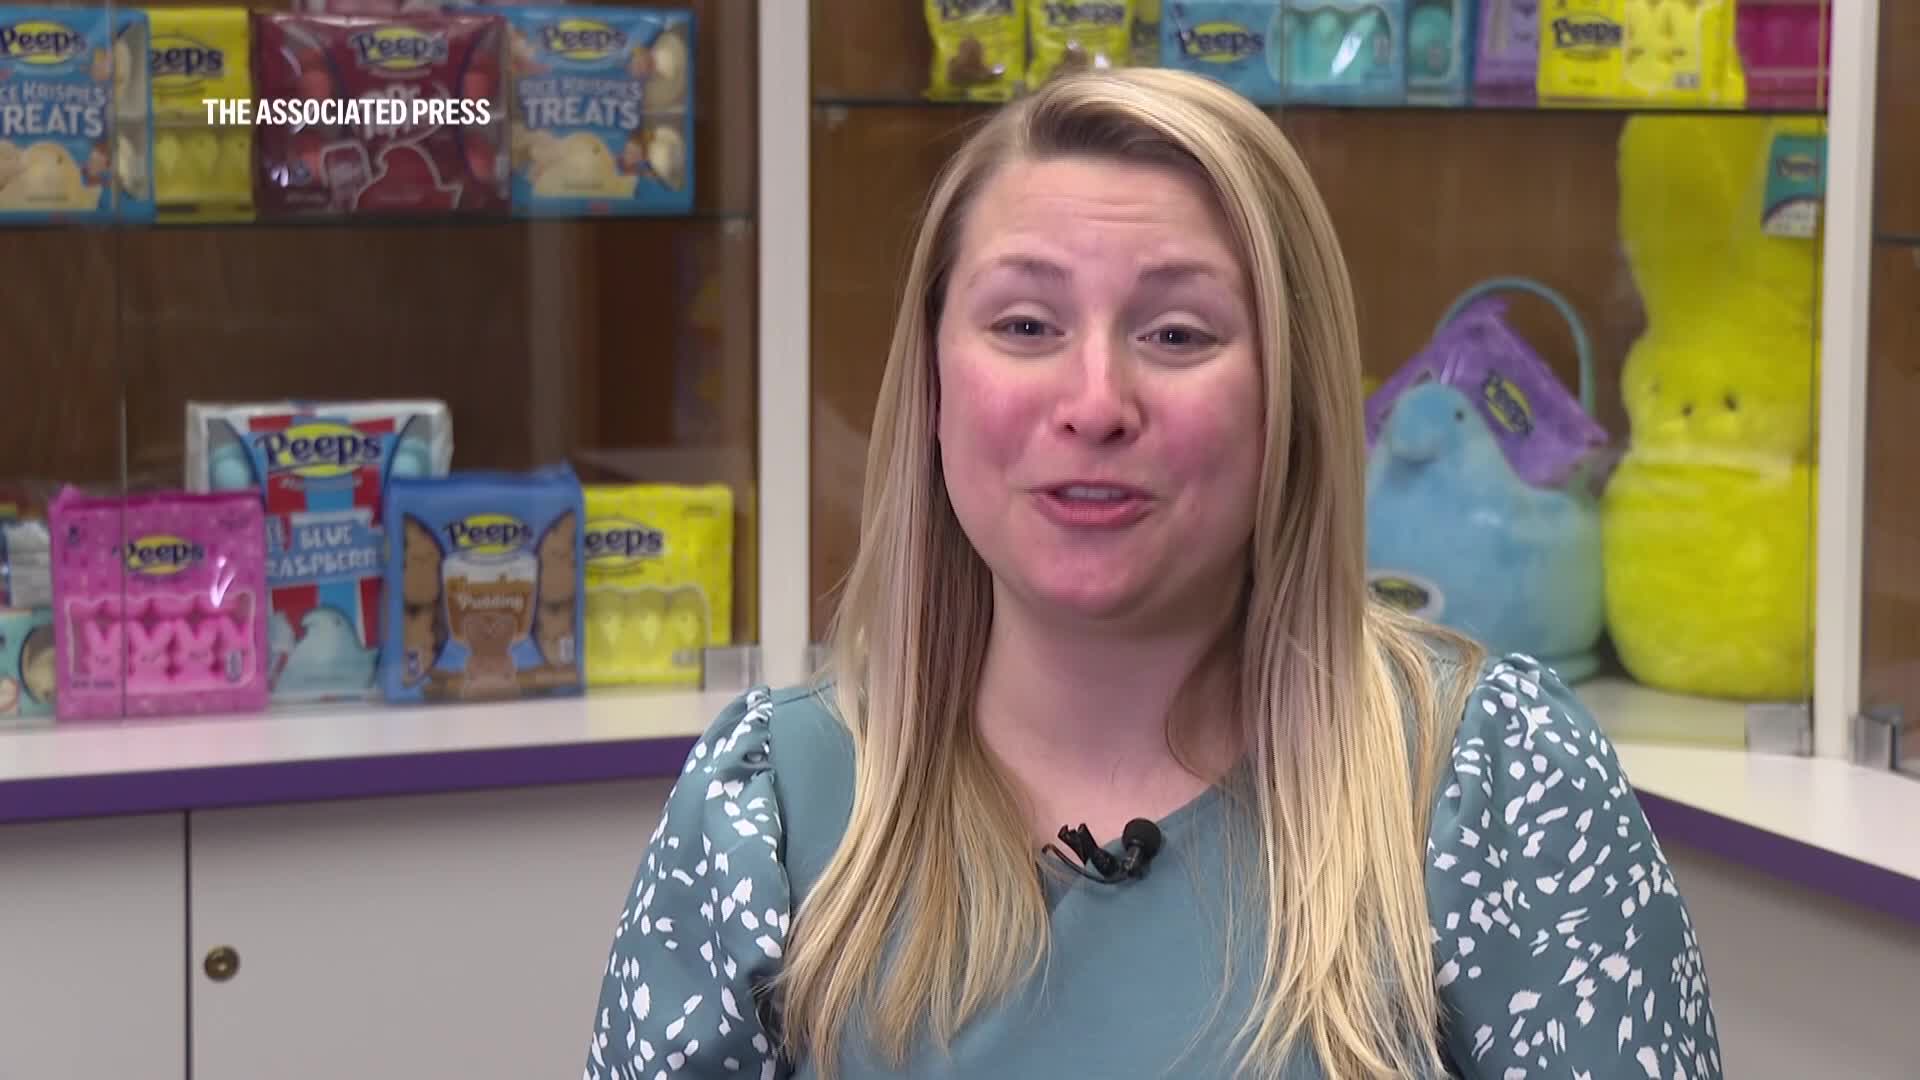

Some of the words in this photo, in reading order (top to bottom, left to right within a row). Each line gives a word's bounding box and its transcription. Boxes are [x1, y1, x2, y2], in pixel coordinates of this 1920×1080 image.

[152, 46, 224, 76] eeps
[0, 104, 104, 138] REATS
[524, 97, 641, 129] TREATS
[257, 431, 382, 470] Peeps
[445, 521, 533, 548] Peeps
[584, 527, 664, 557] eeps
[265, 549, 377, 578] RASPBERR
